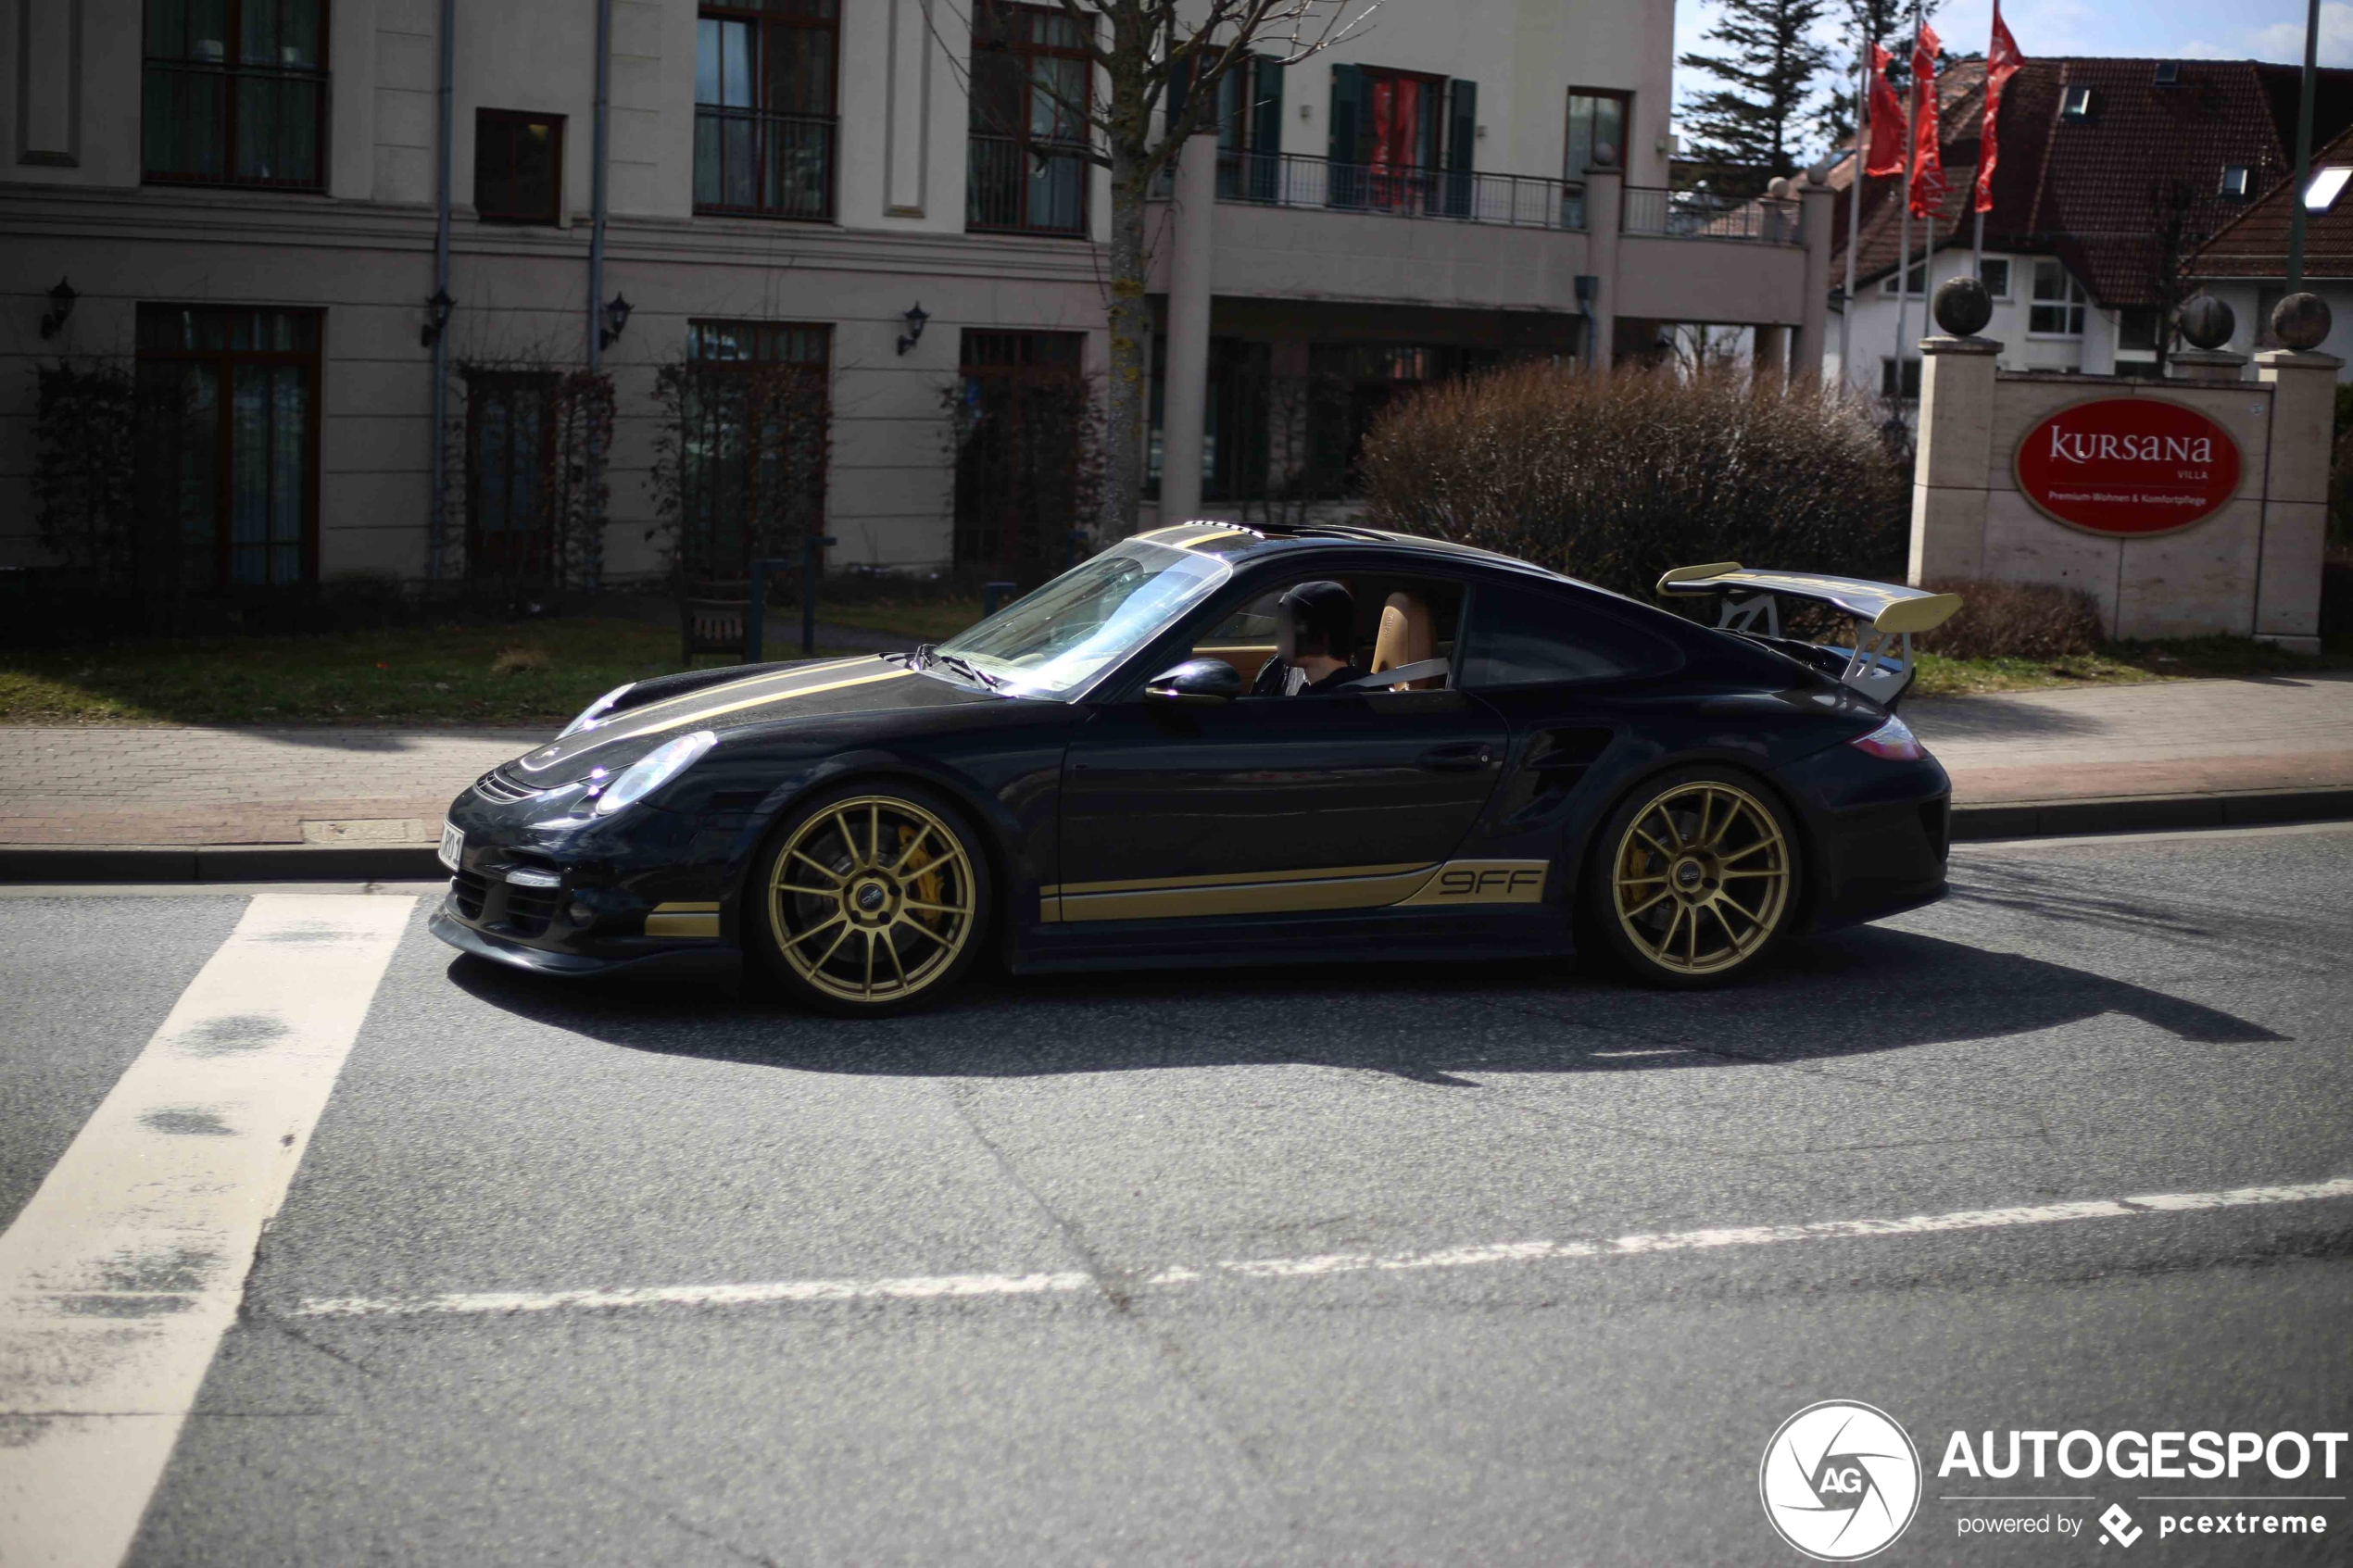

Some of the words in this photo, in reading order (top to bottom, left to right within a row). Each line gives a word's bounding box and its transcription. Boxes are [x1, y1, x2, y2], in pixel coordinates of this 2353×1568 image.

[2177, 470, 2208, 480] VILLA
[2048, 490, 2131, 504] Premium-Wohnen
[2132, 494, 2139, 503] &
[2141, 494, 2207, 507] Komfortpflege
